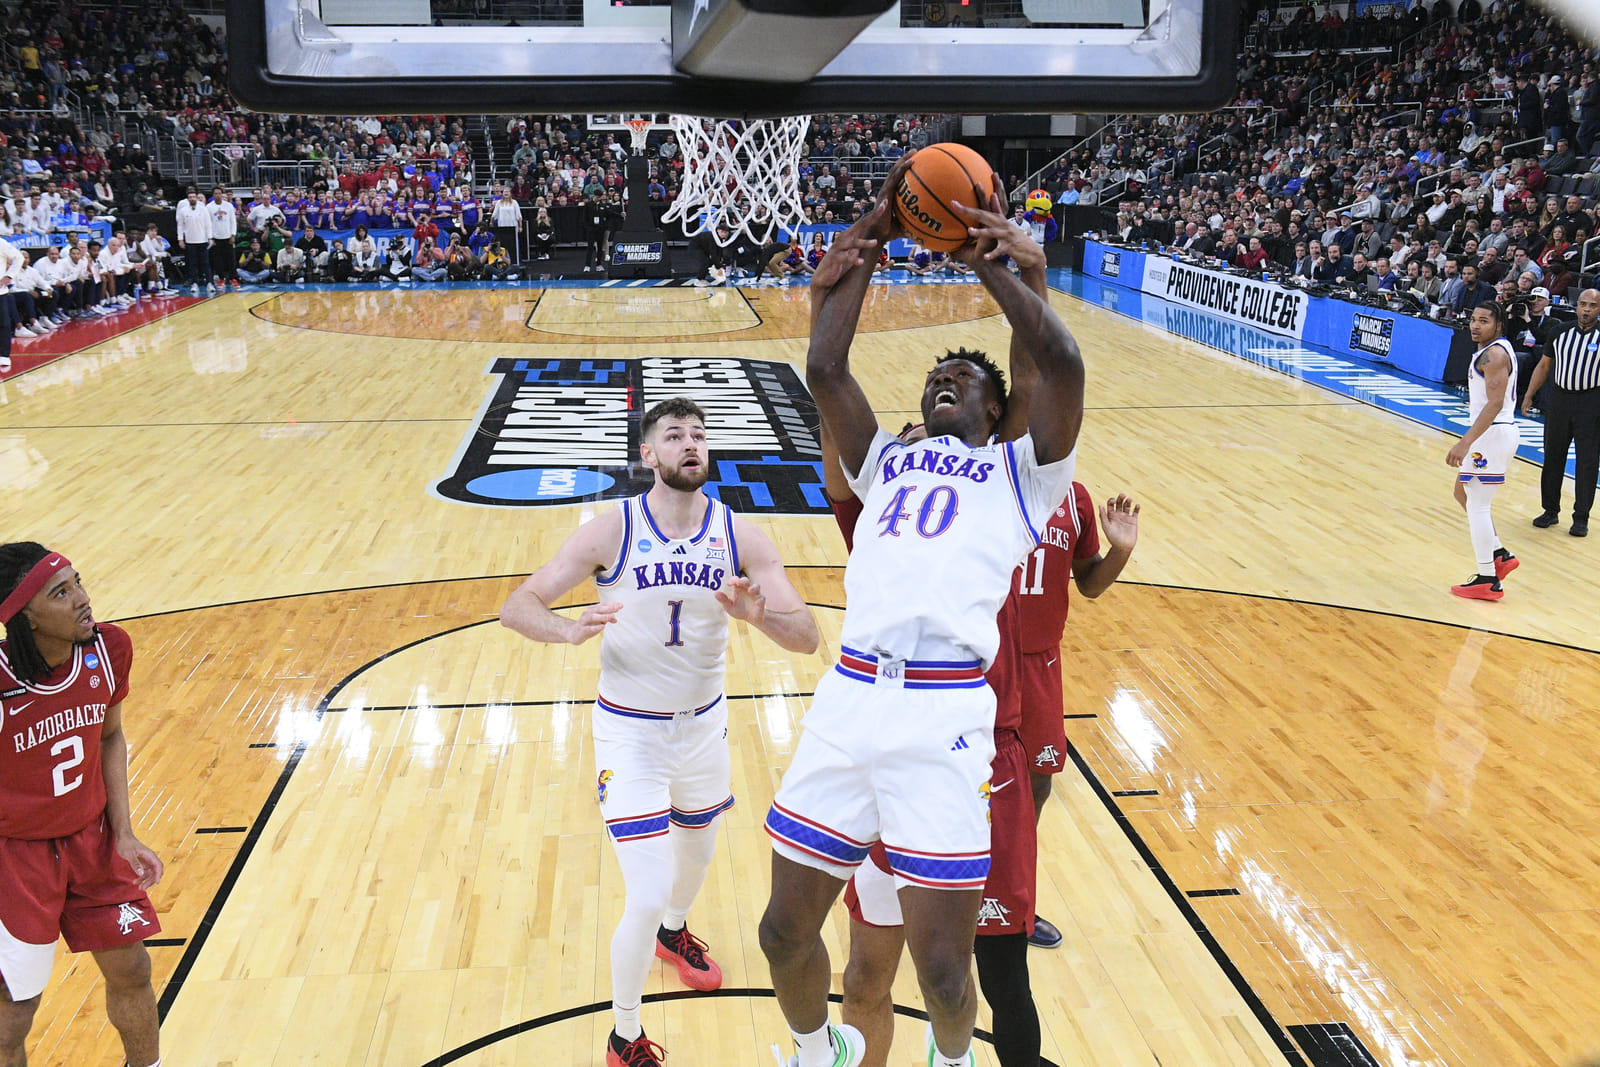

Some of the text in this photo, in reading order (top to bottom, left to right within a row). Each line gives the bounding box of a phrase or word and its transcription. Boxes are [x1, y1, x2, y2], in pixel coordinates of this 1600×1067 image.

[624, 245, 649, 253] MARCH
[626, 252, 661, 261] MADNESS
[1166, 265, 1301, 332] PROVIDENCE COLLEGE
[1359, 316, 1383, 335] MARCH
[1360, 331, 1391, 352] MADNESS
[486, 386, 629, 466] MARCH
[536, 468, 577, 496] NCAA
[882, 449, 995, 485] KANSAS
[877, 485, 959, 539] 40
[632, 561, 725, 591] KANSAS
[1019, 548, 1046, 595] 11
[664, 599, 684, 647] 1
[2, 688, 27, 698] TOGETHER
[13, 703, 107, 753] RAZORBACKS
[50, 735, 85, 797] 2
